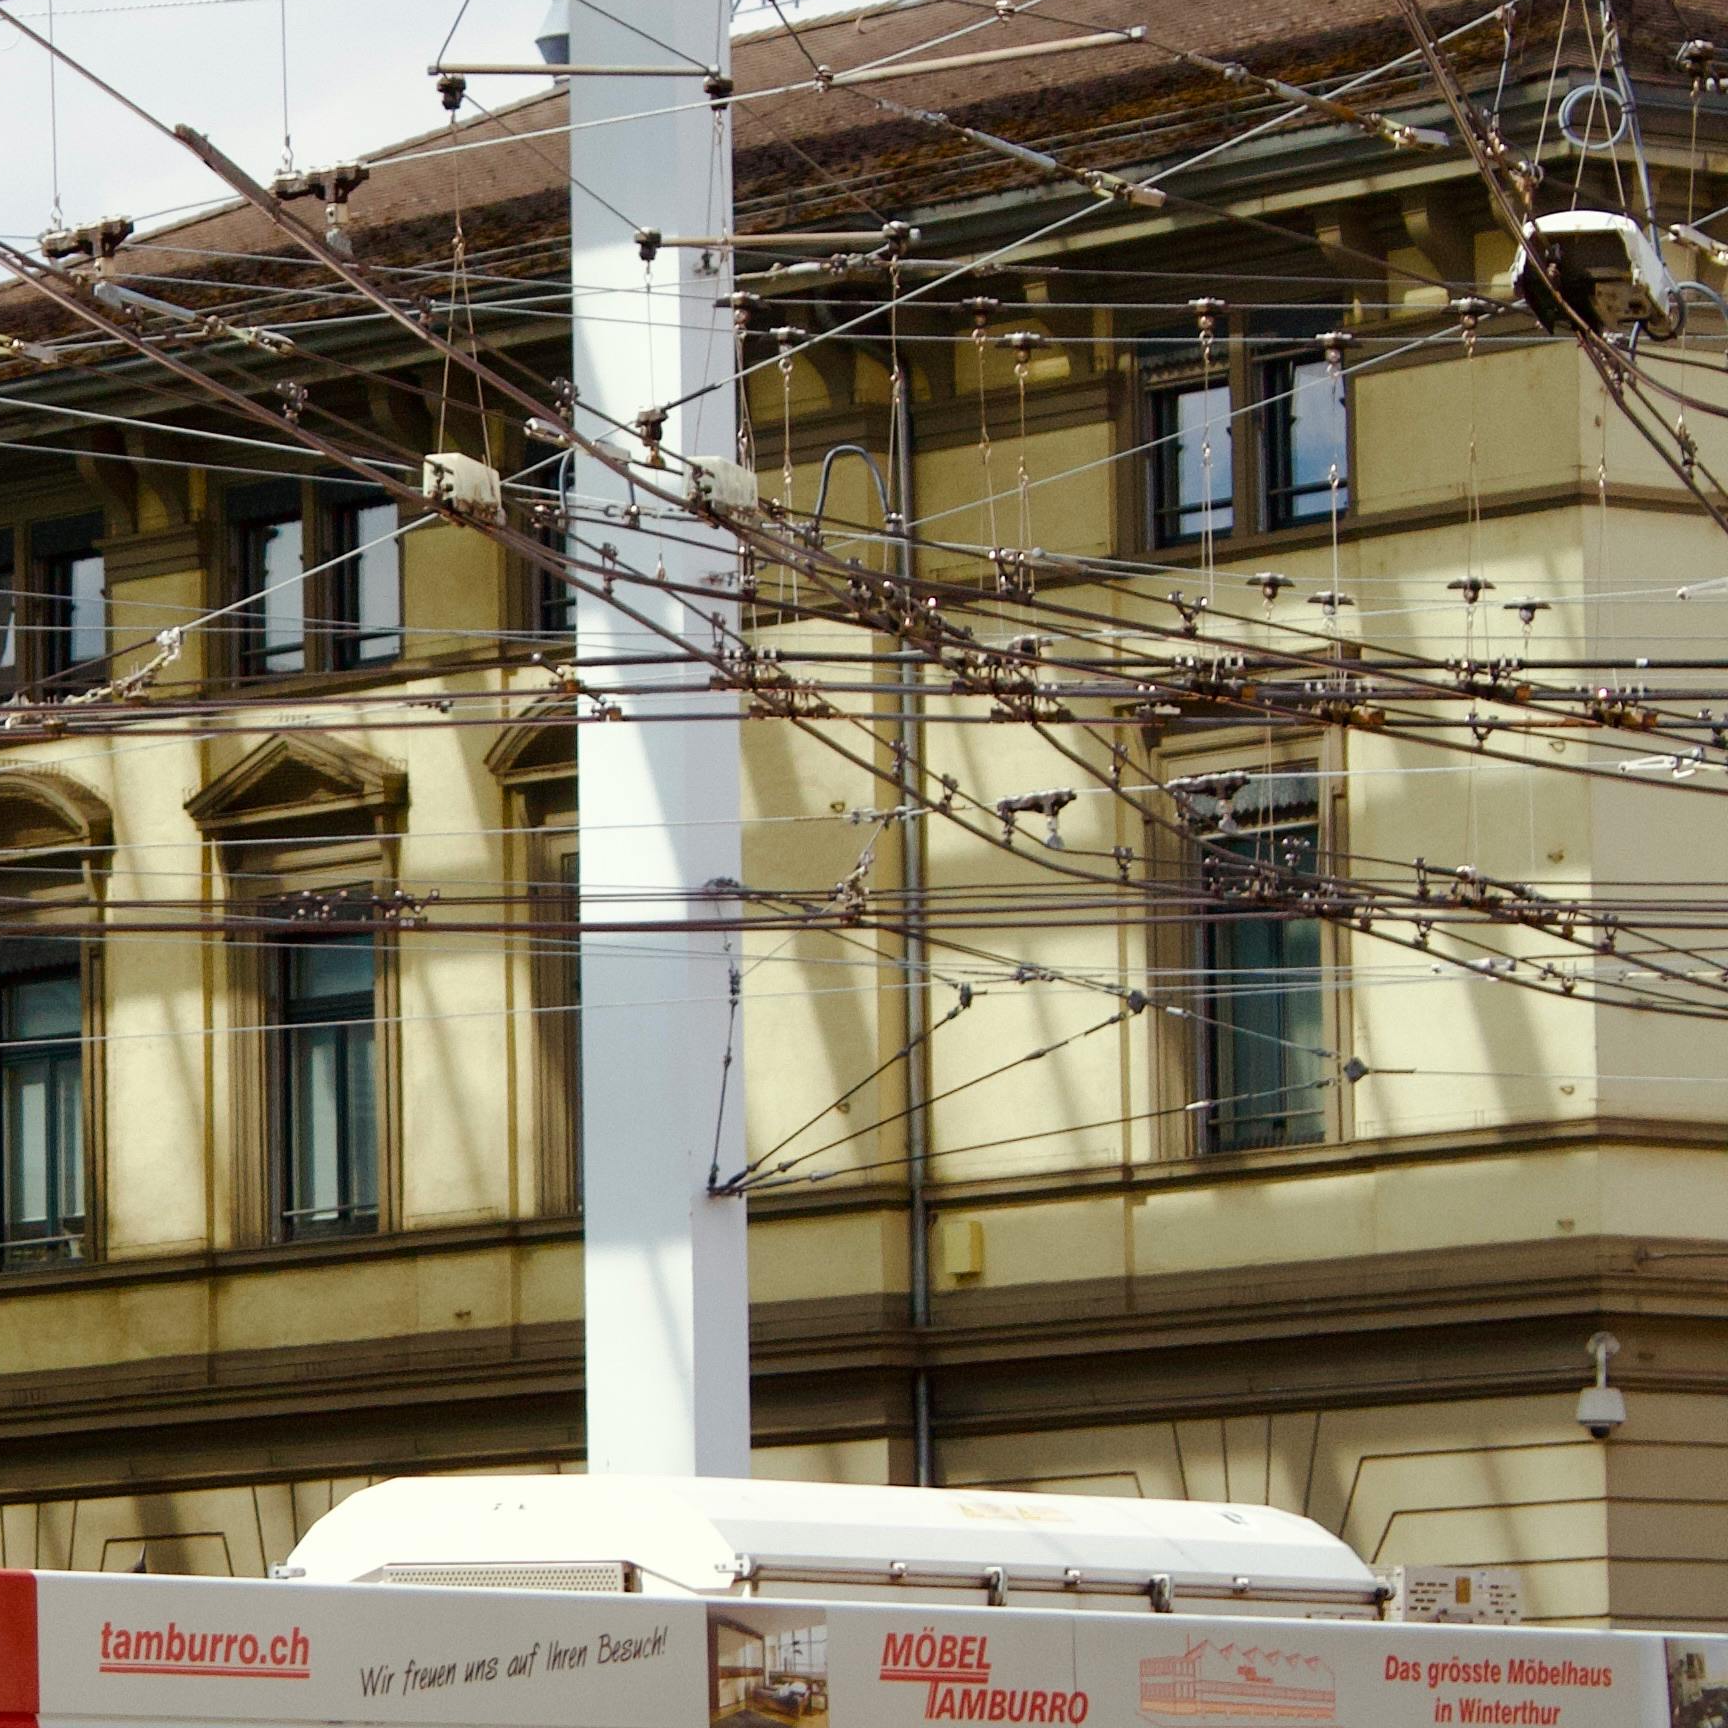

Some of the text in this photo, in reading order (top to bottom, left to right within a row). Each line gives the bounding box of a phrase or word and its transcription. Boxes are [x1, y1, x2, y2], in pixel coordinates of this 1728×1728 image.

[99, 1621, 311, 1667] tamburro.ch
[360, 1625, 668, 1699] Wir freuen uns auf Ihren Besuch!
[880, 1626, 992, 1672] MÖBEL
[1384, 1654, 1613, 1690] Das grösste Möbelhaus
[924, 1676, 1089, 1726] TAMBURRO
[1434, 1697, 1562, 1727] in Winterthur
